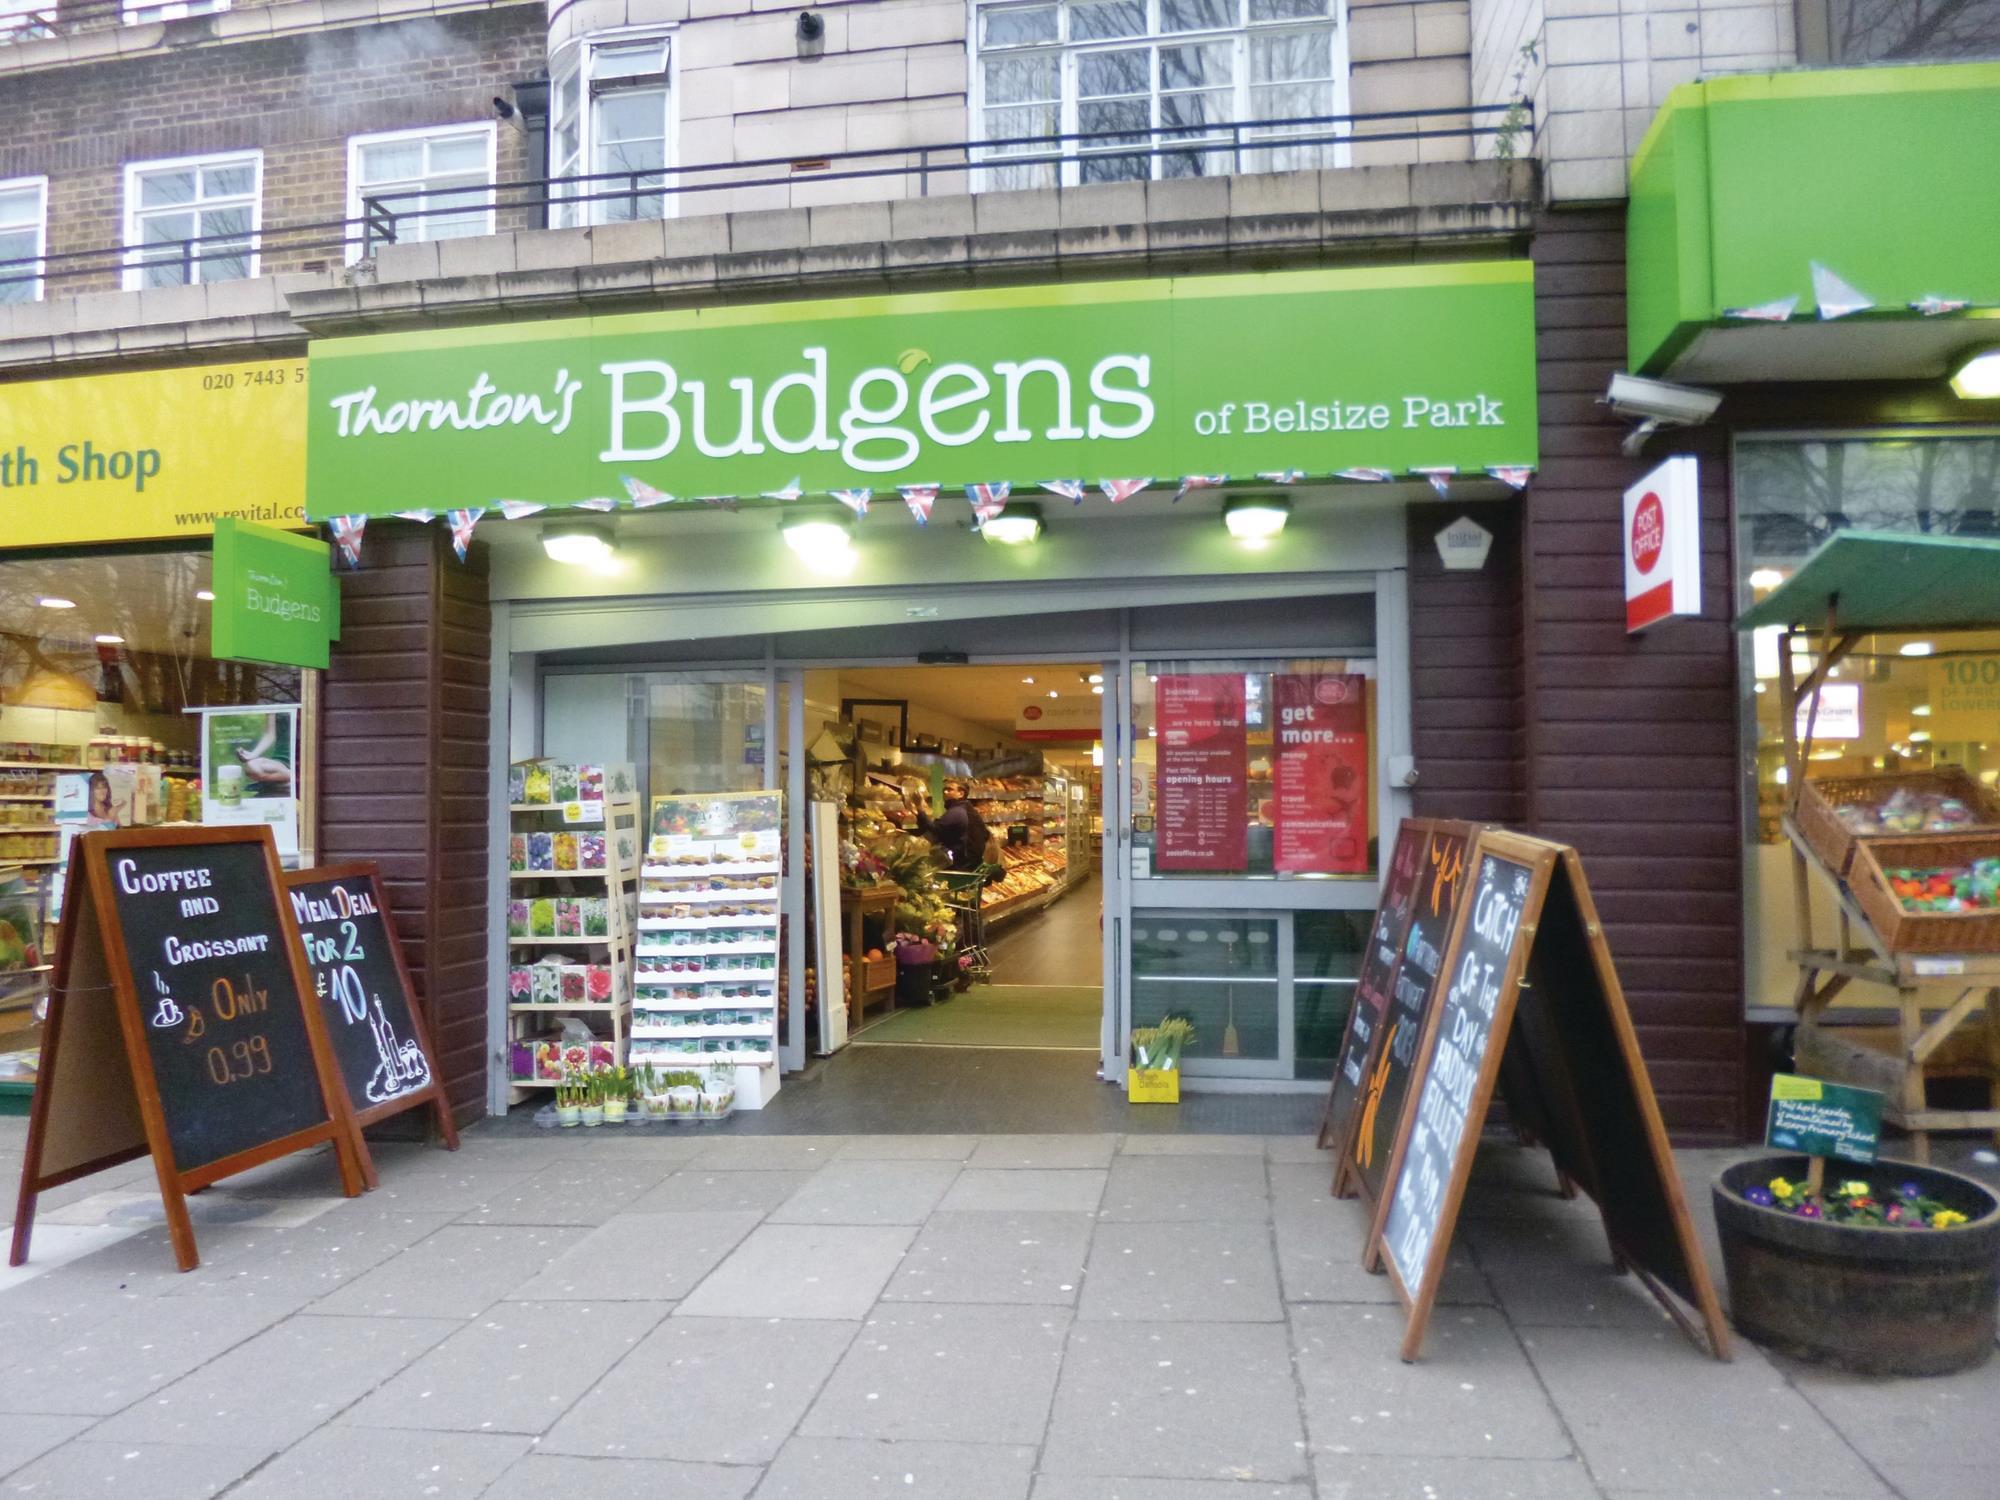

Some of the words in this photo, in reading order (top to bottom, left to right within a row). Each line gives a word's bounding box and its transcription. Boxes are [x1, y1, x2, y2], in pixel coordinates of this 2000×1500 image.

[203, 373, 234, 391] 020
[243, 368, 285, 387] 7443
[330, 368, 581, 438] Thornton's
[600, 346, 1156, 473] Budgens
[1195, 401, 1239, 436] of
[1244, 399, 1390, 433] Belsize
[1403, 394, 1505, 428] Park
[0, 445, 38, 488] th
[57, 440, 162, 492] Shop
[1637, 505, 1658, 532] POST
[1633, 527, 1661, 560] OFFICE
[246, 587, 321, 622] Budgens
[1281, 705, 1316, 725] get
[1281, 729, 1354, 744] more...
[1166, 775, 1203, 785] opening
[1205, 774, 1232, 784] hours
[118, 858, 212, 895] COFFEE
[180, 896, 220, 919] AND
[290, 890, 339, 925] MEAL
[331, 885, 378, 920] DEAL
[1473, 883, 1519, 956] CATCH
[301, 932, 342, 966] FOR
[340, 920, 365, 961] 2
[1452, 1006, 1480, 1061] DAY
[207, 1034, 272, 1085] 0.99
